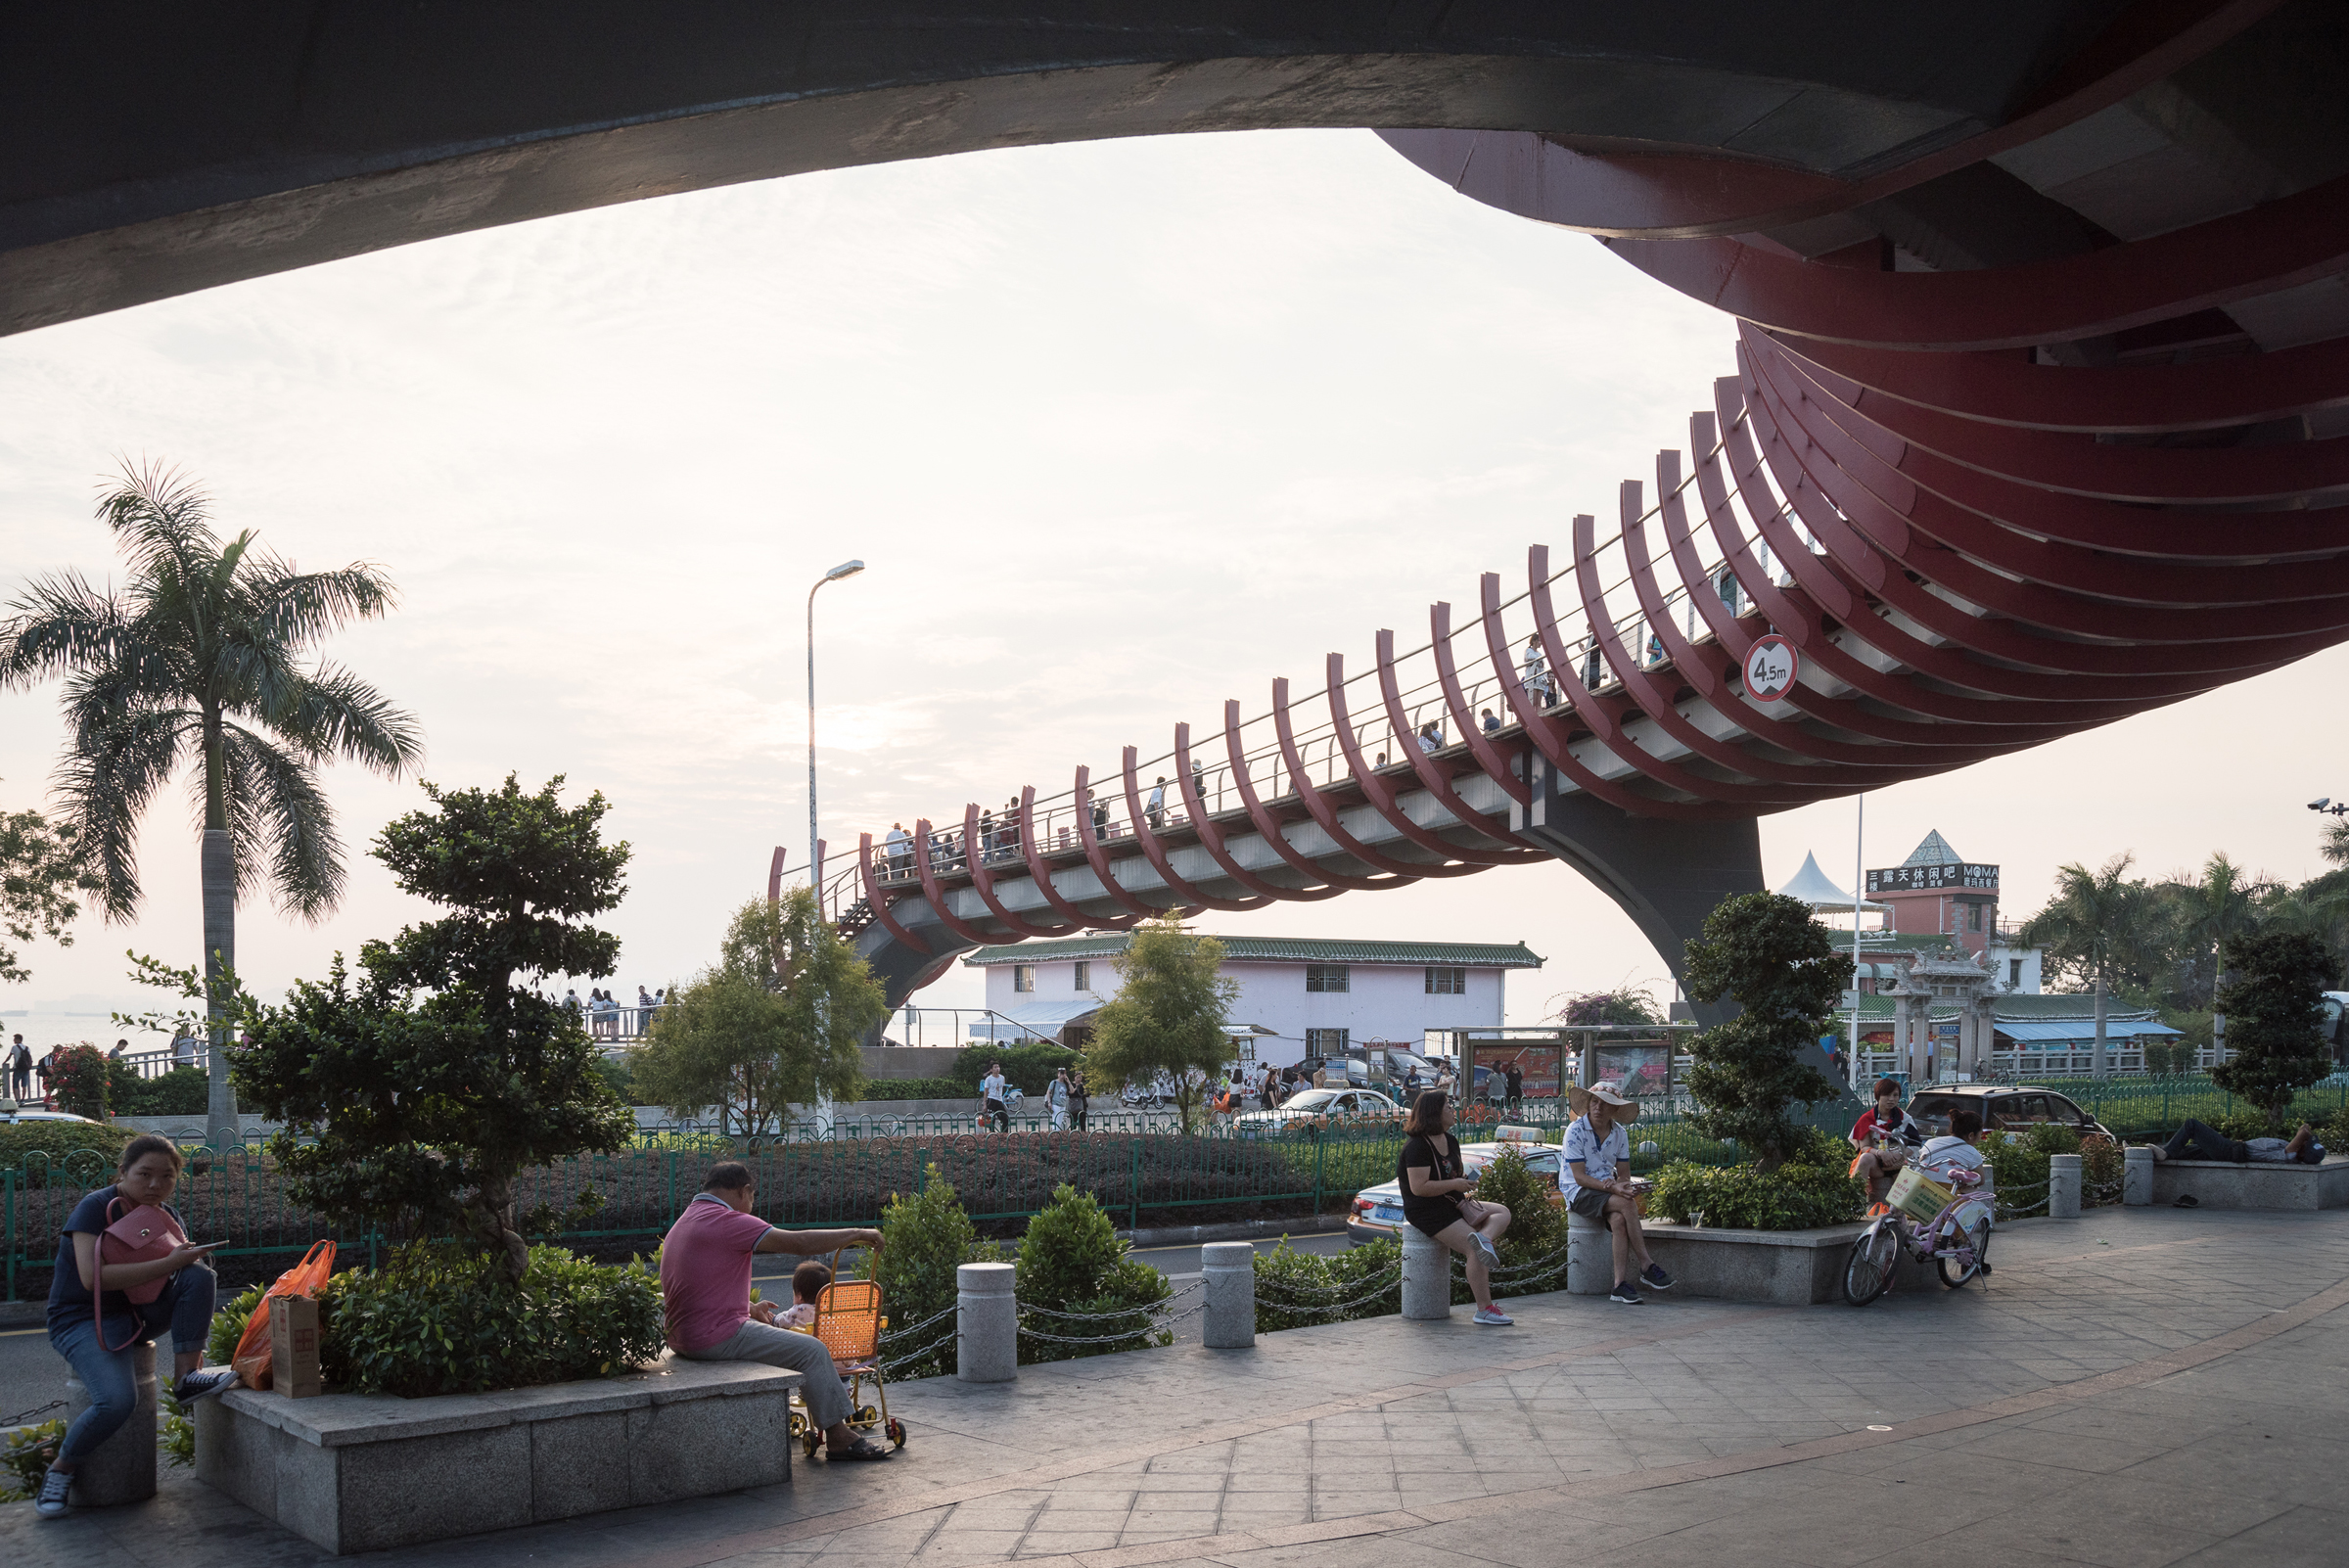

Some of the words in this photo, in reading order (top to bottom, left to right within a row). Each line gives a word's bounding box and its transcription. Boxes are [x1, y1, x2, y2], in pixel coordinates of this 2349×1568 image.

[1753, 657, 1786, 682] 4.5m
[1883, 865, 1956, 883] 露天休闲吧
[1963, 865, 1999, 878] MOMA
